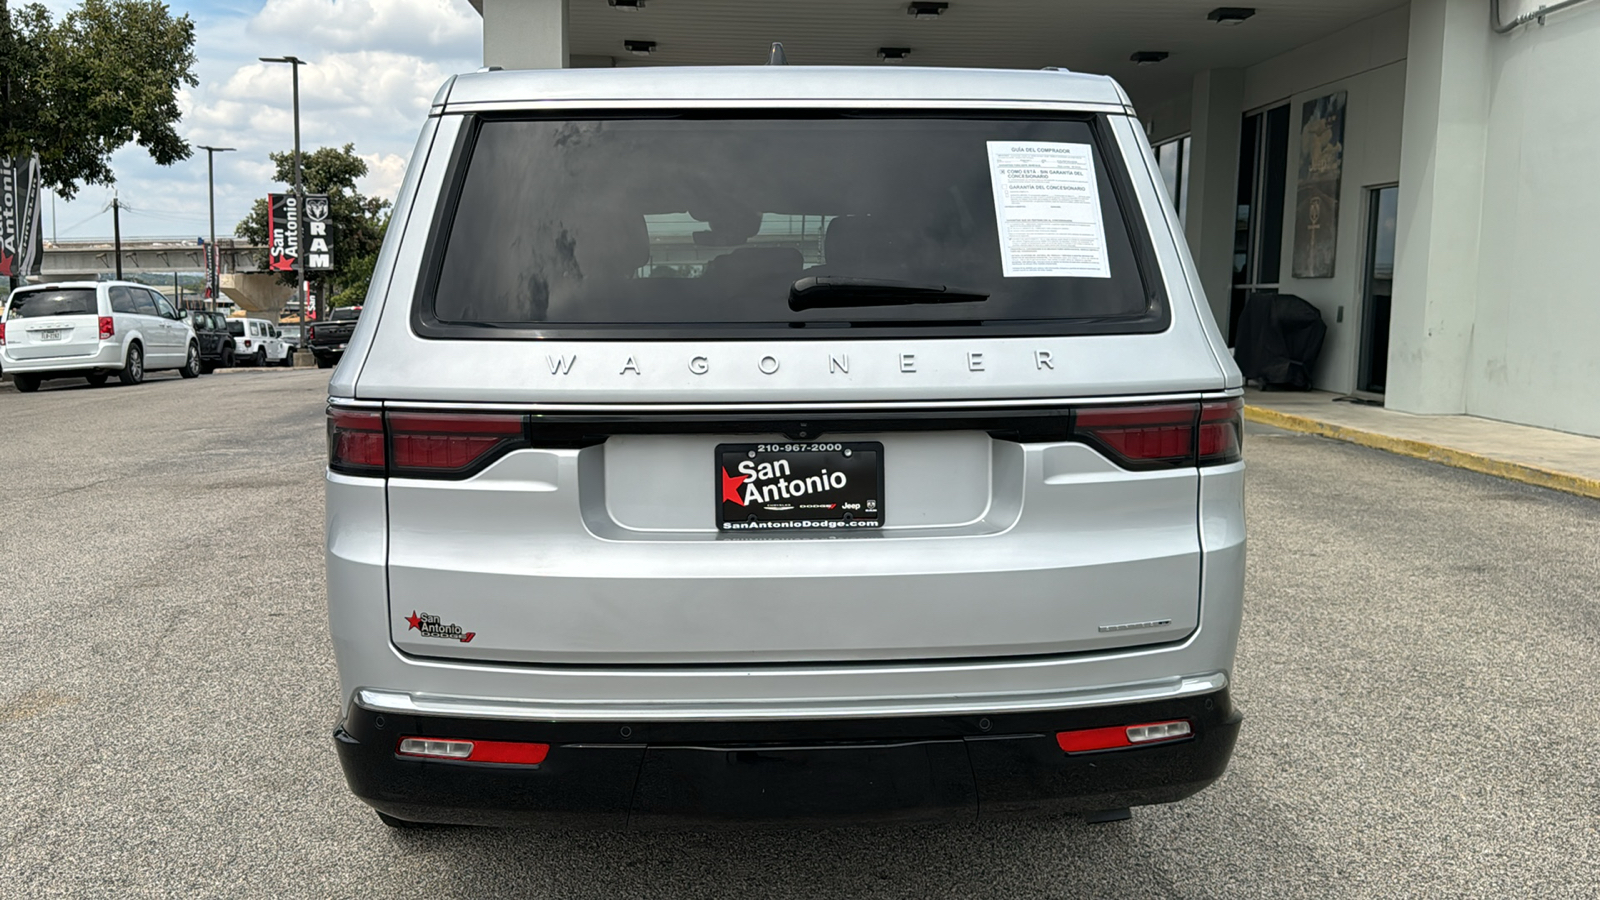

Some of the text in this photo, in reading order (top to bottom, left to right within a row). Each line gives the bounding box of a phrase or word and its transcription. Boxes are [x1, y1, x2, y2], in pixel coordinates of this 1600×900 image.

[284, 197, 298, 257] Antonio
[271, 228, 284, 257] San
[309, 221, 330, 267] RAM
[545, 349, 1055, 375] WAGONEER
[757, 443, 842, 452] 210-967-2000
[738, 459, 791, 483] San
[743, 469, 847, 506] Antonio
[842, 502, 861, 511] Jeep
[723, 520, 879, 530] SanAntonioDodge.com
[420, 612, 440, 623] San
[421, 622, 462, 634] Antonio
